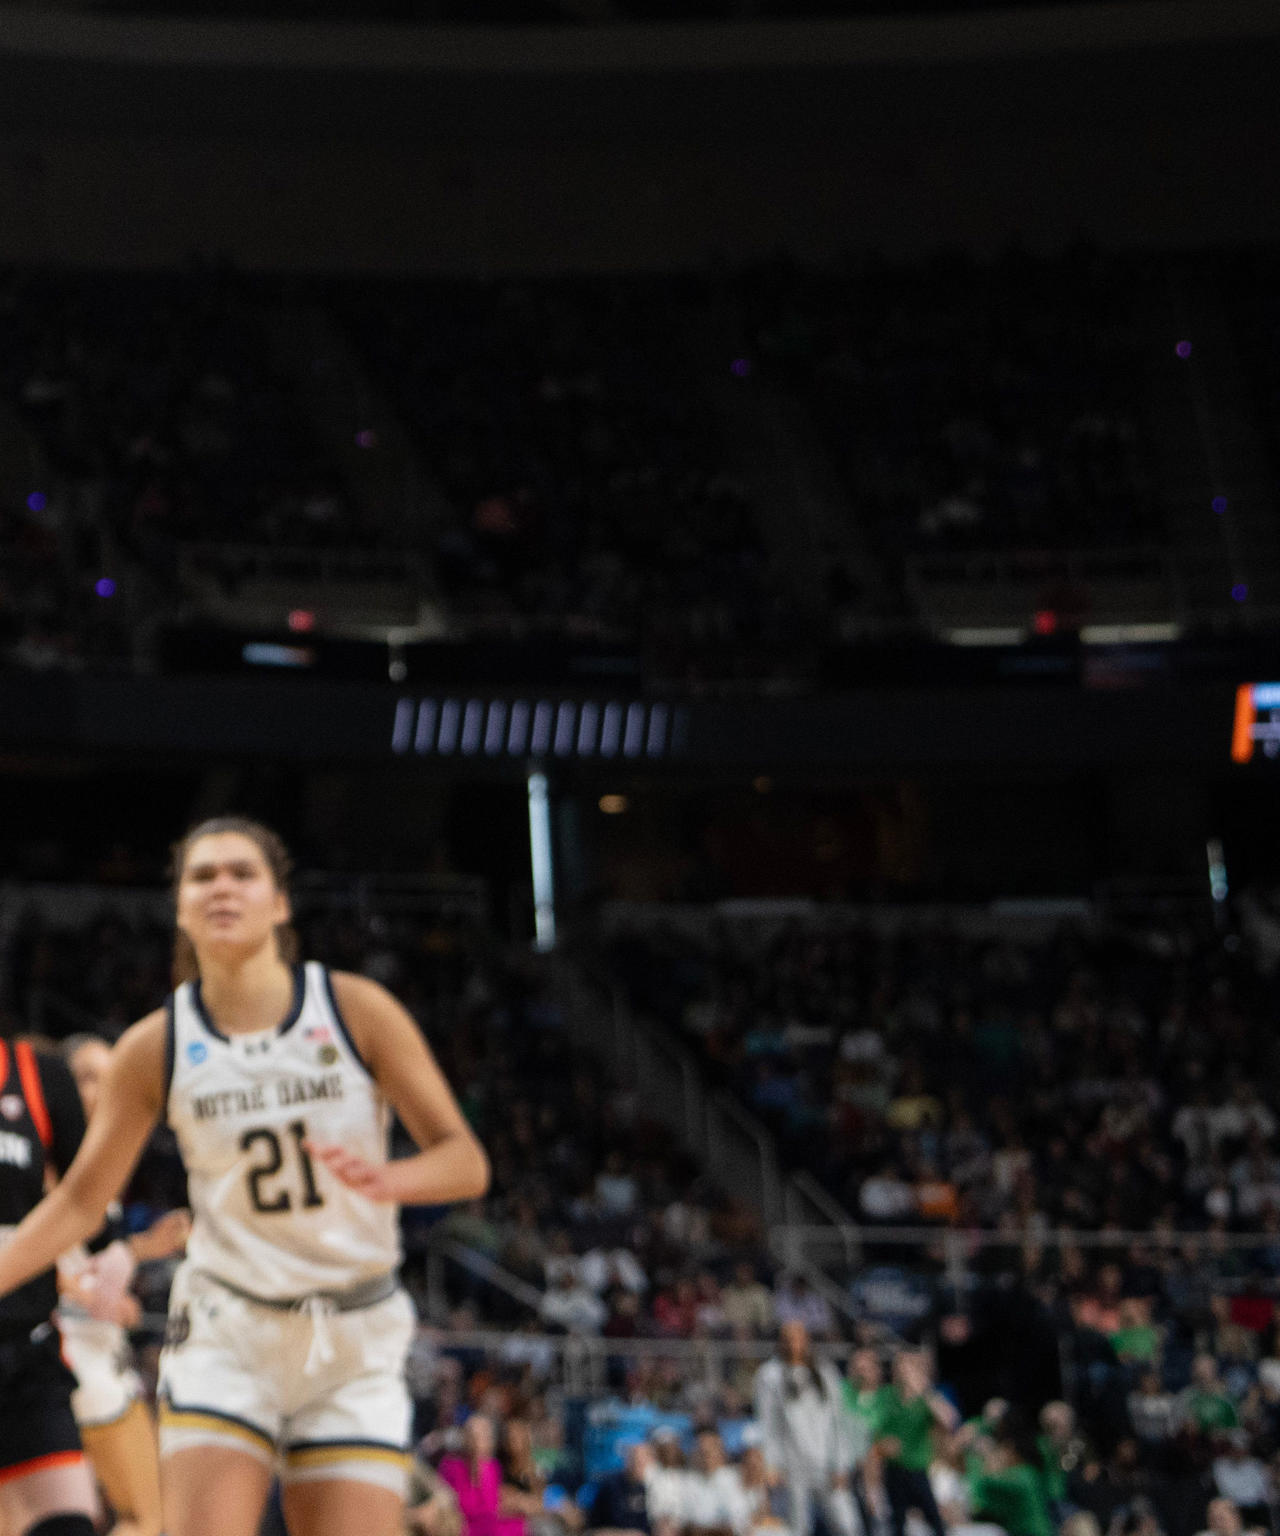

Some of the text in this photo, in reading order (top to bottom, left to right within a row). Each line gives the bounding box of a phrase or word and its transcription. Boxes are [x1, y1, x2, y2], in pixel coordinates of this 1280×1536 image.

[193, 1072, 343, 1120] NOTRE DAME
[239, 1119, 323, 1213] 21
